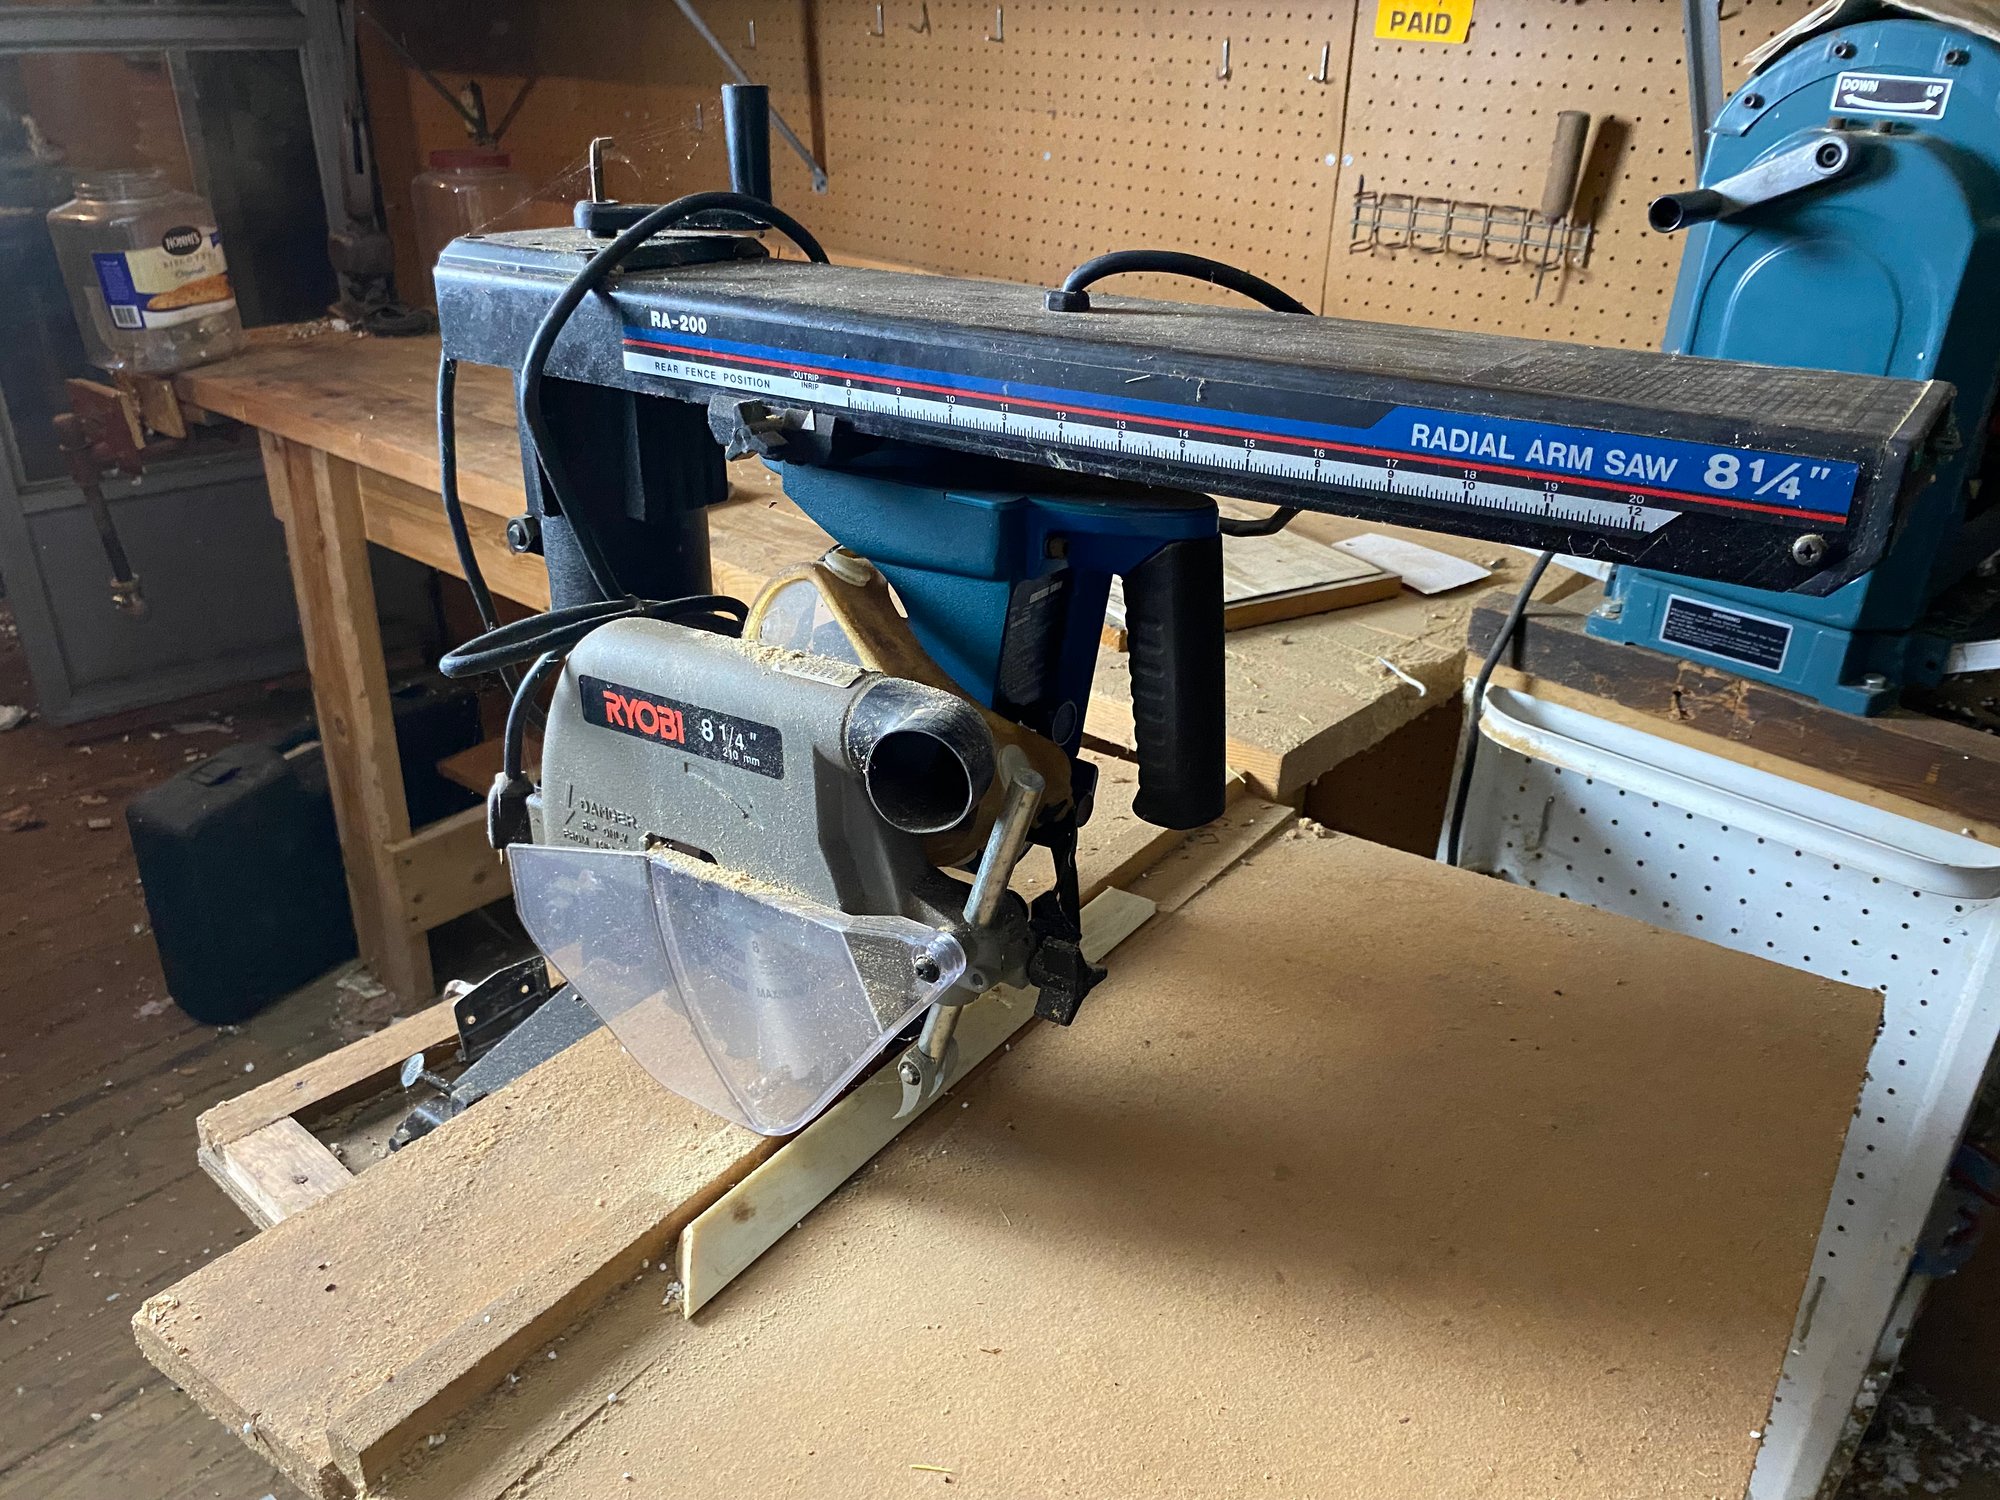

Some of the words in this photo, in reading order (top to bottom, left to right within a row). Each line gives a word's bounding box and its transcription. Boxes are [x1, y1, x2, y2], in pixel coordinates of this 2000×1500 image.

[1390, 11, 1452, 34] PAID
[1841, 79, 1879, 93] DOWN
[1926, 85, 1944, 97] UP
[650, 310, 707, 335] RA-200
[654, 361, 679, 374] REAR
[685, 366, 717, 380] FENCE
[723, 372, 771, 389] POSITION
[793, 370, 820, 382] OUTRIP
[800, 381, 820, 391] INRIP
[845, 379, 852, 388] 8
[895, 386, 902, 395] 9
[945, 395, 956, 404] 10
[1000, 403, 1009, 412] 11
[1056, 411, 1067, 421] 12
[1116, 420, 1127, 430] 13
[1178, 429, 1189, 439] 14
[1243, 439, 1256, 449] 15
[1312, 448, 1326, 459] 16
[1386, 458, 1399, 469] 17
[1463, 469, 1478, 480] 18
[1544, 481, 1559, 492] 19
[1629, 494, 1645, 504] 20
[846, 388, 852, 397] 0
[948, 404, 953, 413] 2
[1001, 413, 1007, 421] 3
[1058, 422, 1064, 430] 4
[1117, 430, 1123, 439] 5
[1180, 439, 1186, 448] 6
[1246, 449, 1252, 459] 7
[1314, 459, 1321, 469] 8
[1387, 469, 1394, 480] 9
[1461, 480, 1476, 491] 10
[1542, 492, 1555, 503] 11
[1628, 505, 1642, 517] 12
[1411, 423, 1515, 460] RADIAL
[1524, 438, 1594, 472] ARM
[1604, 448, 1678, 483] SAW
[1712, 611, 1741, 624] WARNING
[602, 690, 685, 744] RYOBI
[722, 747, 739, 761] 210
[743, 755, 761, 767] mm
[580, 799, 640, 830] DANGER
